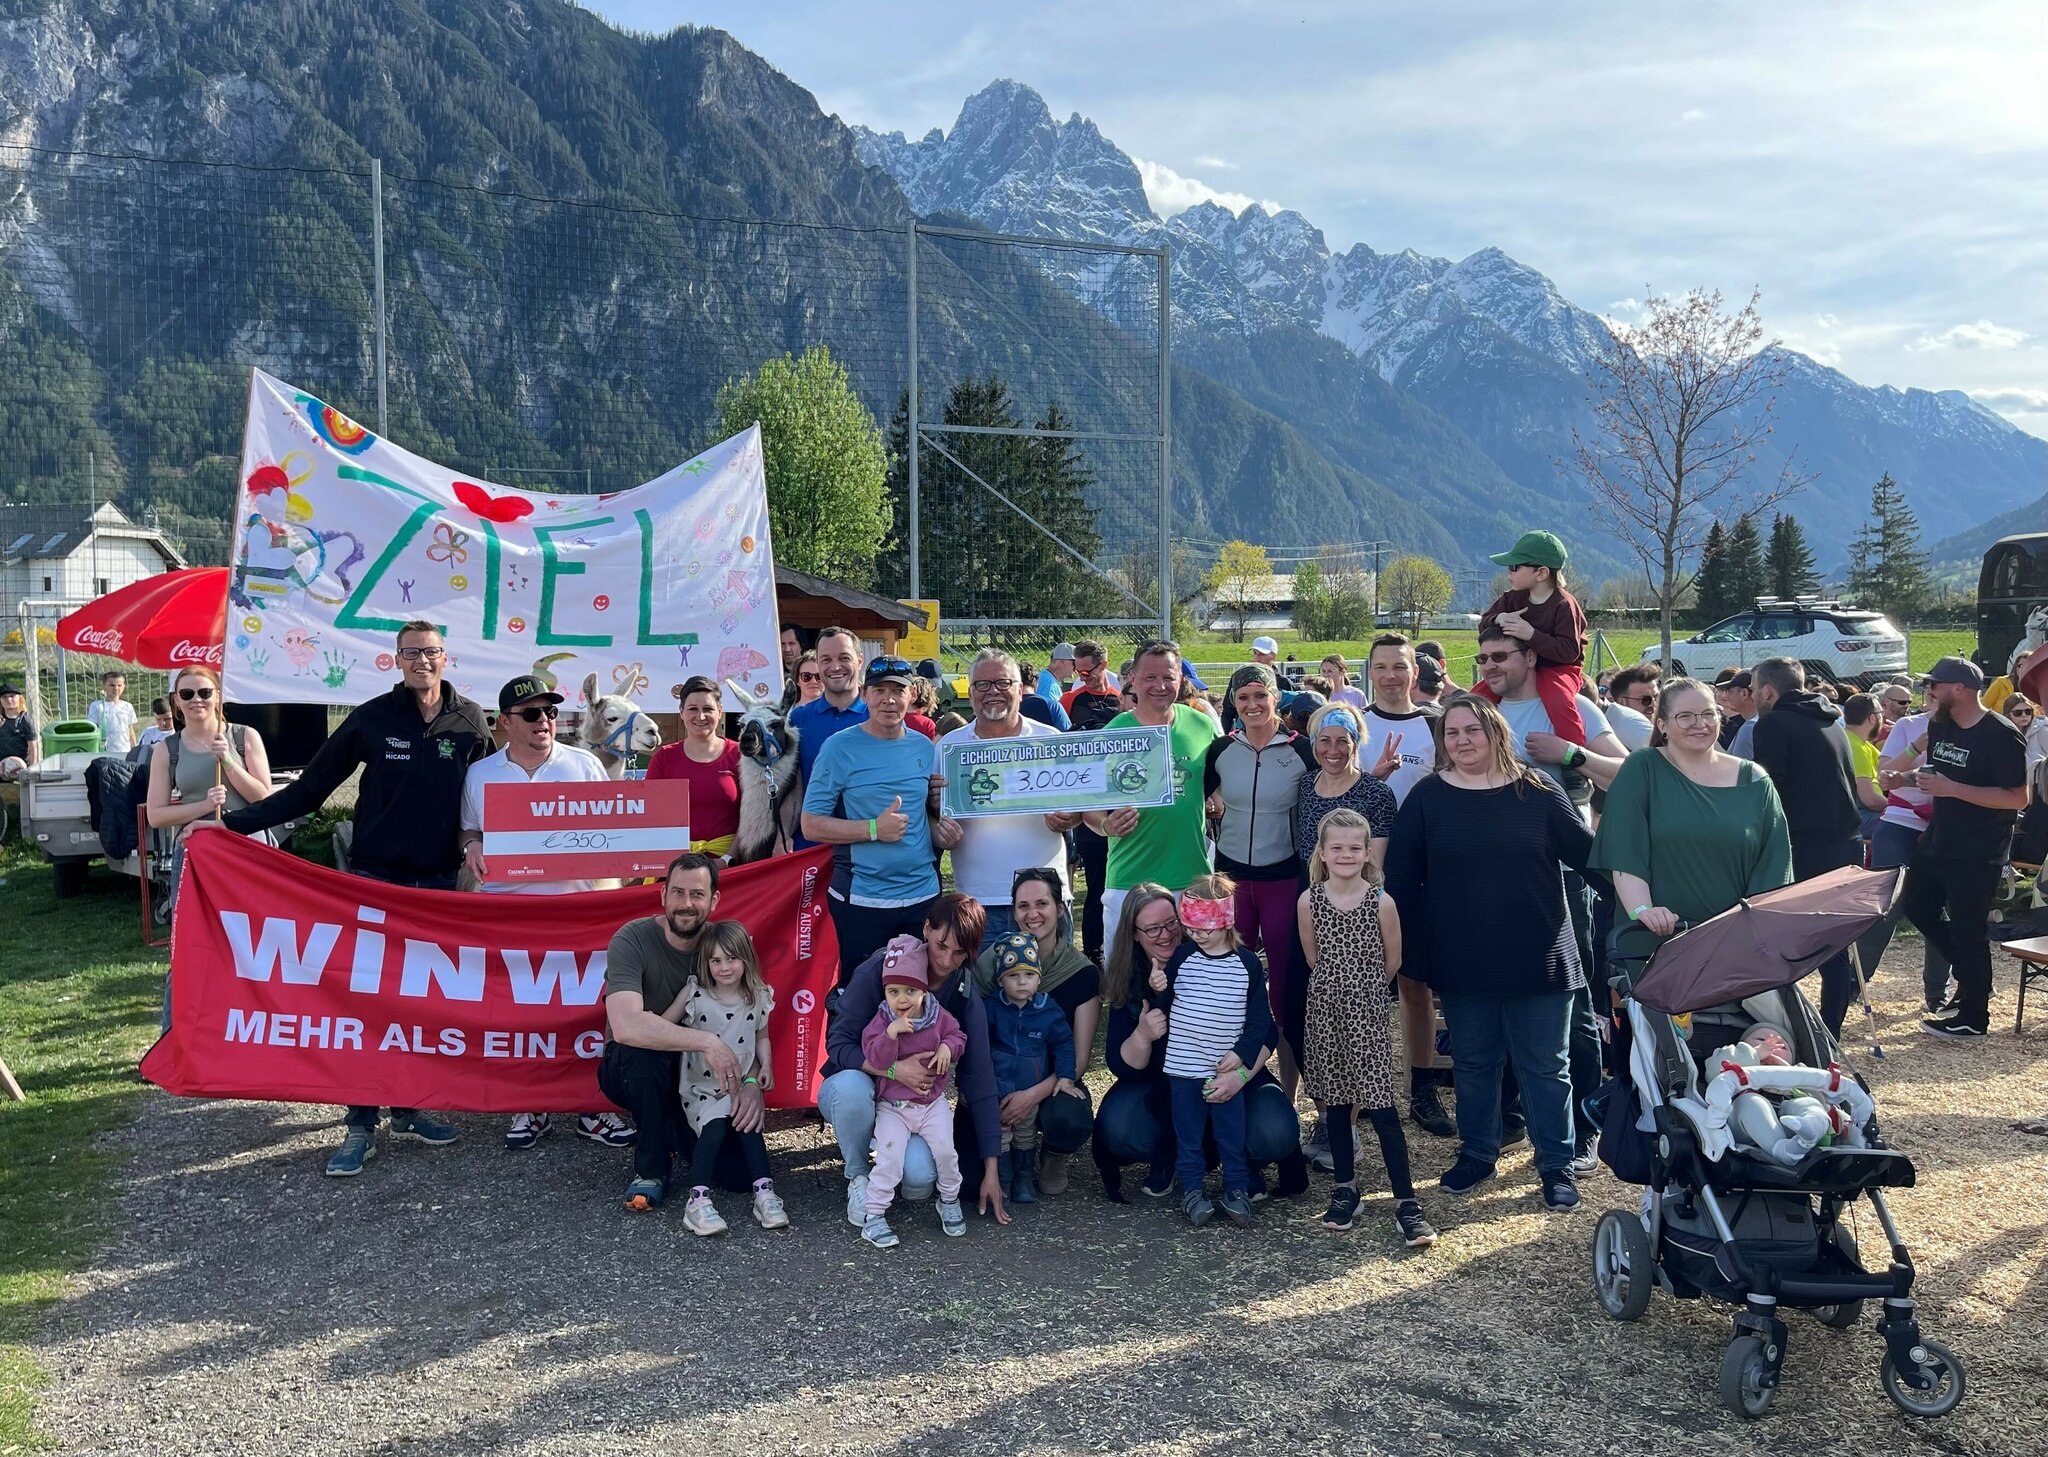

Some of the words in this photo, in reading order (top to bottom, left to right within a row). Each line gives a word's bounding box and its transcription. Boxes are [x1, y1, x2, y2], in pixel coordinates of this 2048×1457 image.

[334, 464, 699, 646] ZIEL
[514, 681, 535, 697] DM
[960, 749, 1011, 765] EICHHOLZ
[1012, 745, 1057, 761] TURTLES
[1059, 737, 1151, 758] SPENDENSCHECK
[1017, 768, 1093, 791] 3.000€
[801, 866, 818, 907] CASINOS
[799, 911, 813, 961] AUSTRIA
[225, 1008, 364, 1051] MEHR
[378, 1023, 467, 1056] ALS
[484, 1031, 557, 1059] EIN
[796, 1017, 804, 1091] LOTTERIEN
